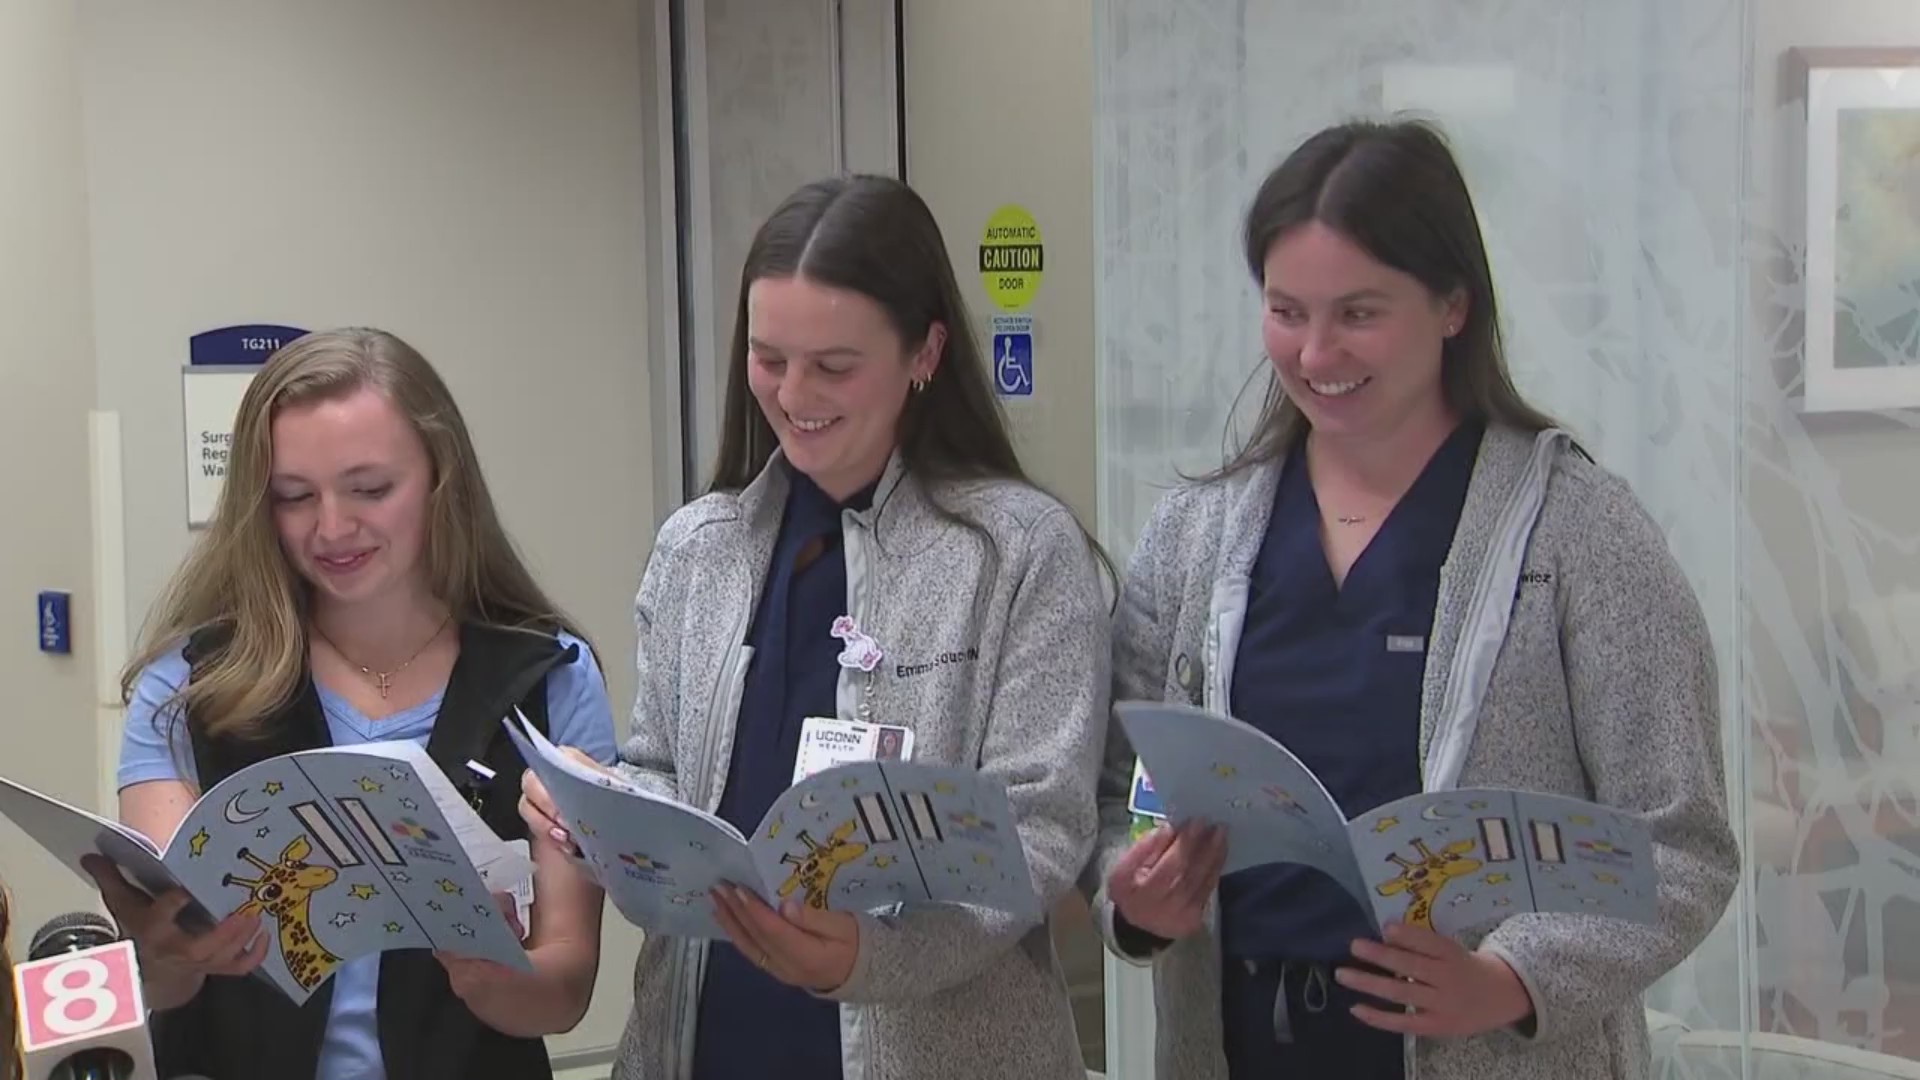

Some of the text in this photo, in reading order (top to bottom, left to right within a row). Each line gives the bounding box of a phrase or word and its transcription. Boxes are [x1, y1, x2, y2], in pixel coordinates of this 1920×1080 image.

[986, 226, 1036, 239] AUTOMATIC
[983, 248, 1040, 269] CAUTION
[998, 278, 1024, 289] DOOR
[242, 338, 280, 350] TG211
[816, 730, 861, 744] UCONN
[818, 742, 855, 752] HEALTH
[43, 958, 117, 1035] 8
